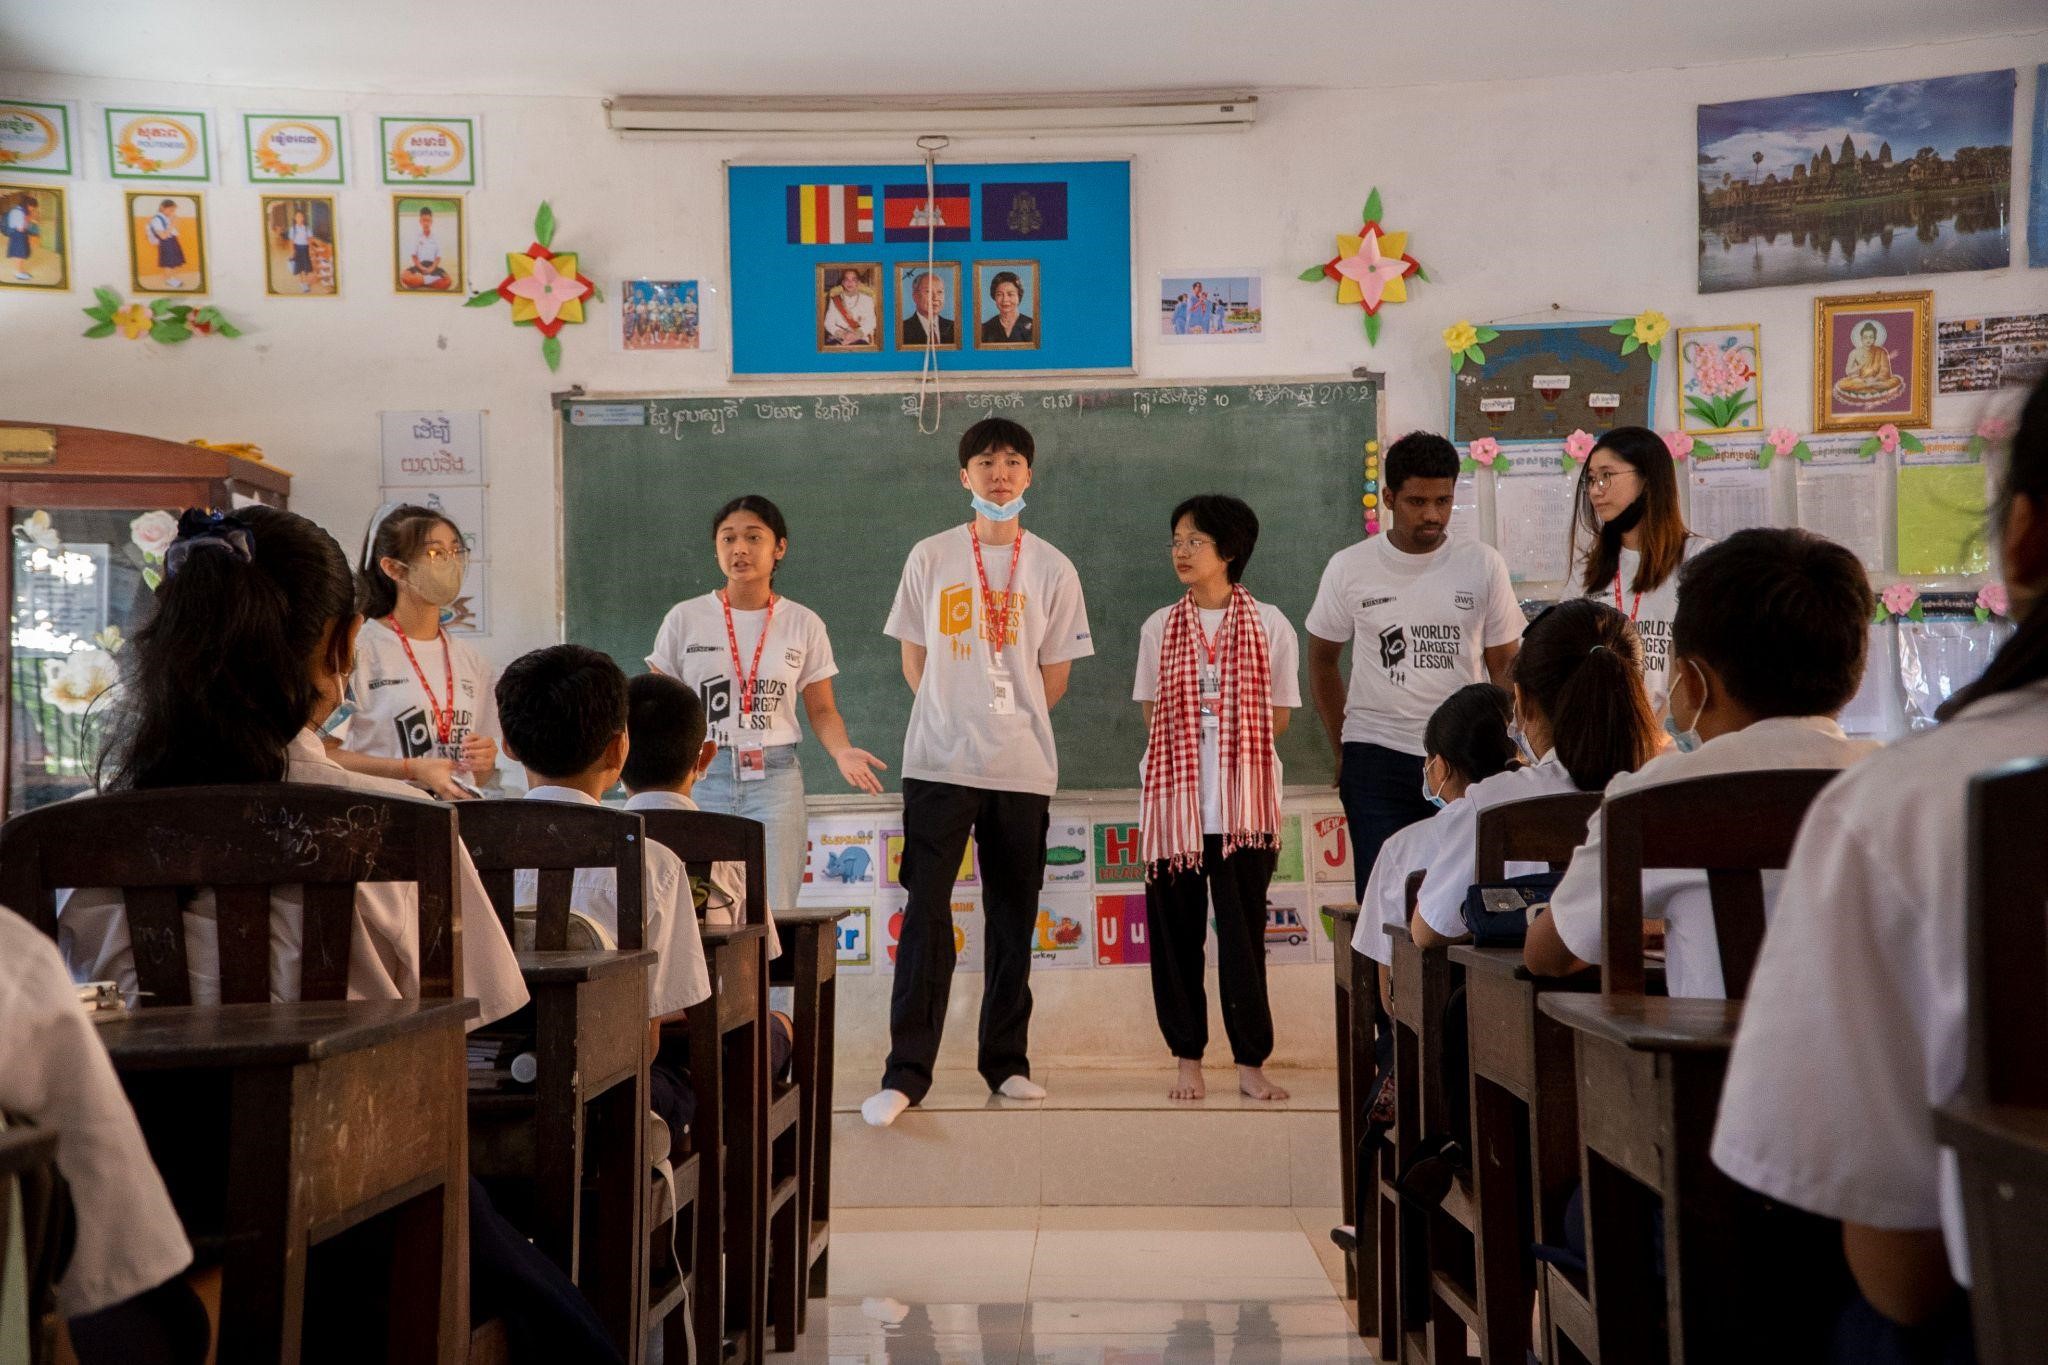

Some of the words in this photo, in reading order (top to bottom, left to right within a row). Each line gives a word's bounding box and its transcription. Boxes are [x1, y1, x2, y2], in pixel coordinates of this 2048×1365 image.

[1213, 394, 1230, 407] 10
[1410, 624, 1461, 640] WORLD'S
[1636, 620, 1673, 637] ORLD'S
[1413, 639, 1461, 655] LARGEST
[1643, 637, 1673, 655] GEST
[1413, 654, 1455, 670] LESSON
[1644, 655, 1665, 672] SON
[1105, 826, 1140, 866] H
[1324, 827, 1346, 868] J
[1102, 916, 1118, 946] U
[1130, 922, 1145, 944] u
[1032, 951, 1057, 961] urkey
